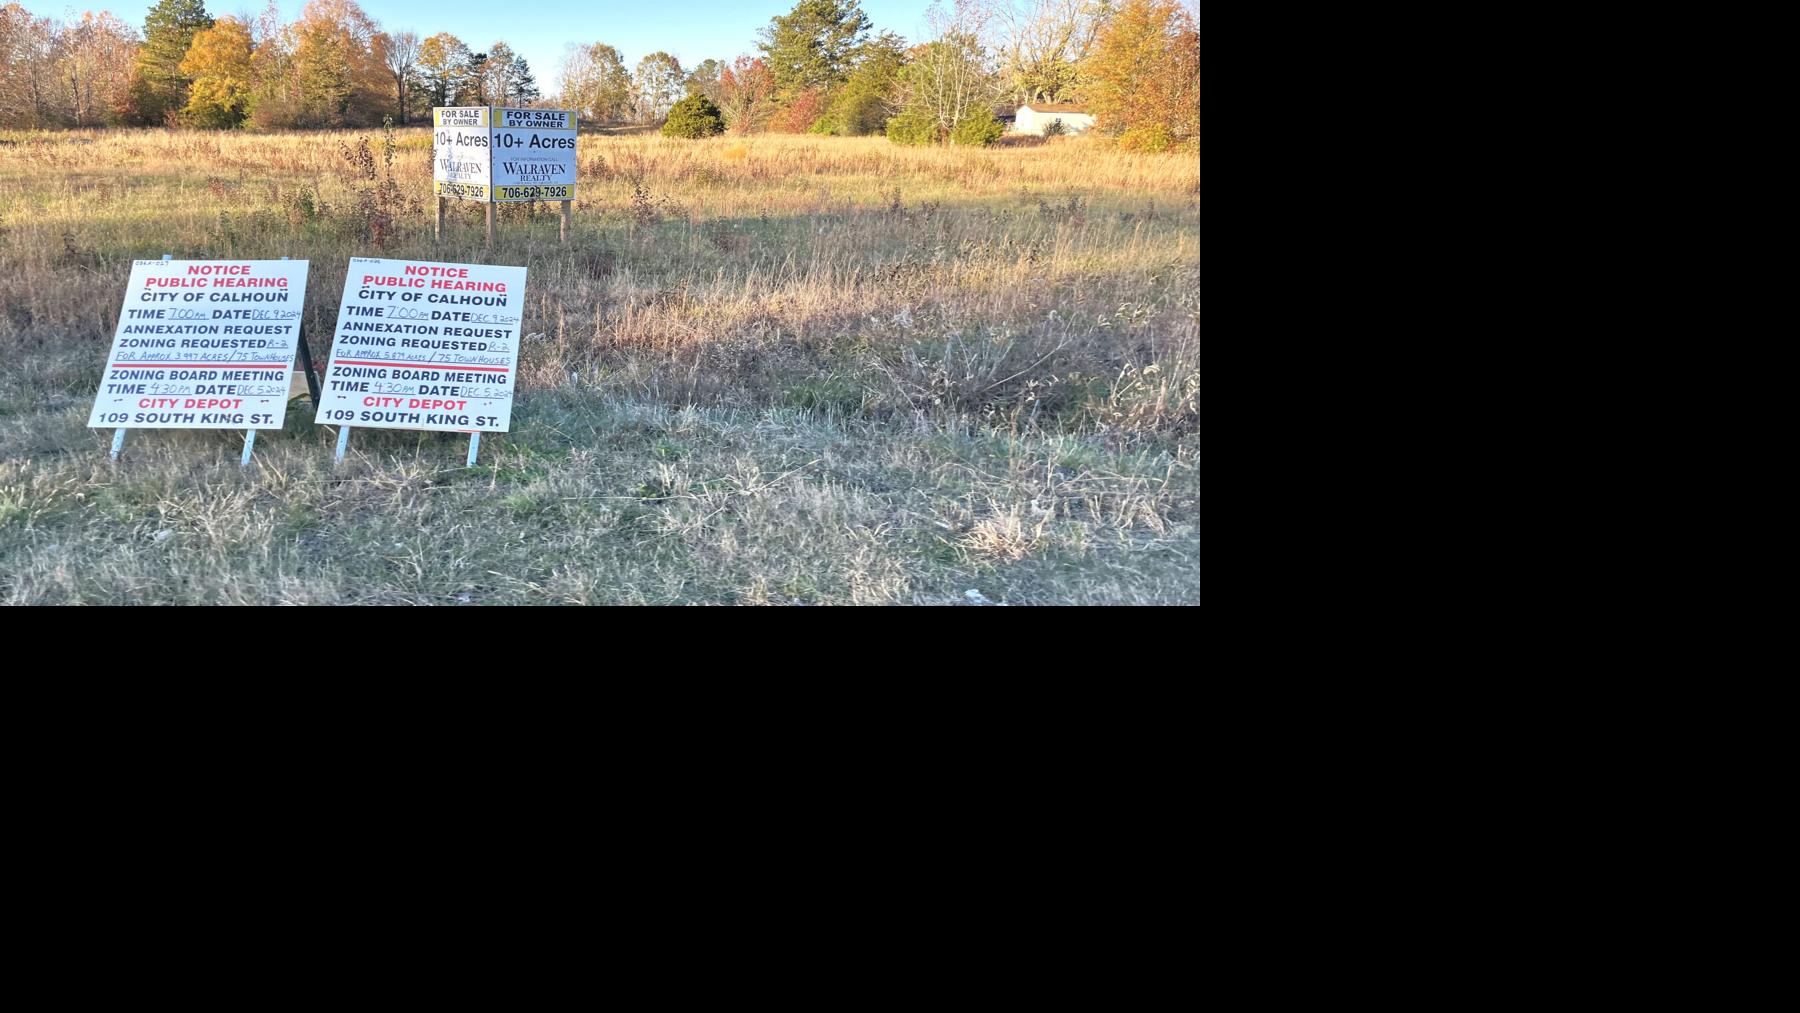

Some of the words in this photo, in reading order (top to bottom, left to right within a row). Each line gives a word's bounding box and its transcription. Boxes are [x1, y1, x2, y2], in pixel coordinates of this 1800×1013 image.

[534, 112, 565, 120] SALE
[435, 132, 452, 145] 10+
[456, 133, 488, 147] Acres
[494, 134, 523, 148] 10+
[529, 134, 575, 148] Acres
[440, 159, 482, 173] WALRAVEN
[503, 162, 566, 174] WALRAVEN
[440, 183, 483, 197] 706-629-7926
[502, 187, 566, 198] 706-629-7926
[188, 266, 251, 275] NOTICE
[405, 266, 469, 278] NOTICE
[146, 278, 207, 287] PUBLIC
[213, 278, 288, 287] HEARING
[363, 276, 425, 288] PUBLIC
[431, 280, 506, 293] HEARING
[141, 293, 178, 302] CITY
[184, 293, 204, 302] OF
[209, 293, 288, 302] CALHOUN
[358, 290, 396, 300] CITY
[401, 293, 423, 302] OF
[428, 294, 507, 307] CALHOUN
[128, 310, 165, 318] TIME
[212, 310, 250, 319] DATE
[252, 309, 270, 319] DEC
[346, 306, 384, 317] TIME
[431, 311, 471, 321] DATE
[471, 312, 488, 322] DEC
[123, 326, 218, 334] ANNEXATION
[223, 326, 292, 335] REQUEST
[343, 322, 439, 335] ANNEXATION
[443, 328, 512, 338] REQUEST
[120, 339, 176, 348] ZONING
[181, 339, 266, 348] REQUESTED
[340, 335, 396, 347] ZONING
[401, 339, 487, 351] REQUESTED
[110, 371, 164, 380] ZONING
[169, 371, 218, 380] BOARD
[222, 372, 284, 381] MEETING
[332, 367, 387, 379] ZONING
[392, 370, 440, 382] BOARD
[444, 372, 507, 384] MEETING
[107, 384, 146, 394] TIME
[195, 385, 236, 395] DATE
[237, 385, 254, 395] DEC
[331, 381, 369, 392] TIME
[419, 385, 460, 396] DATE
[461, 386, 480, 397] DEC
[139, 399, 179, 408] CITY
[184, 399, 242, 408] DEPOT
[363, 397, 403, 408] CITY
[409, 399, 467, 410] DEPOT
[99, 413, 128, 423] 109
[134, 414, 194, 423] SOUTH
[200, 414, 244, 423] KING
[250, 414, 274, 424] ST.
[325, 410, 354, 420] 109
[360, 412, 420, 423] SOUTH
[426, 414, 469, 425] KING
[476, 417, 499, 427] ST.
